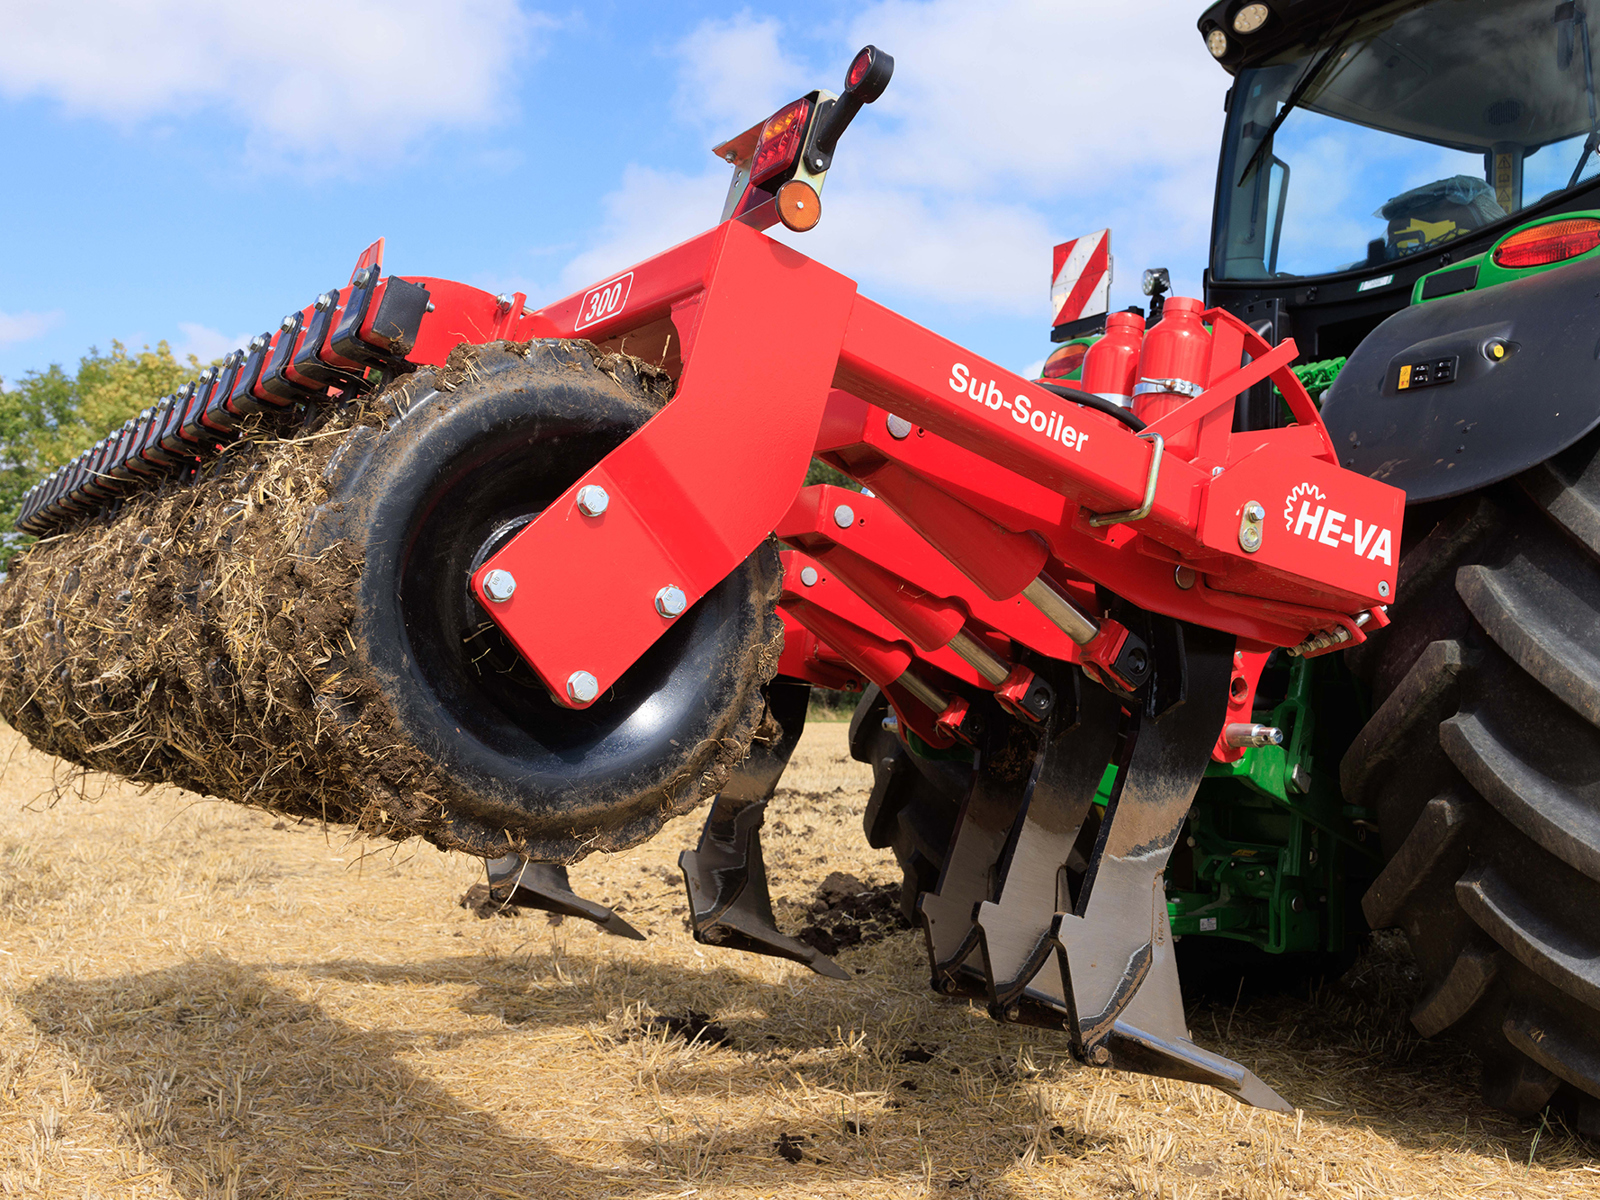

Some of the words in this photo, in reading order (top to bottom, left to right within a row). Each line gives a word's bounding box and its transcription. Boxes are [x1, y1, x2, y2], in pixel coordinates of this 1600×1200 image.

[585, 282, 622, 321] 300
[948, 362, 1089, 452] Sub-Soiler
[1293, 500, 1391, 566] HE-VA
